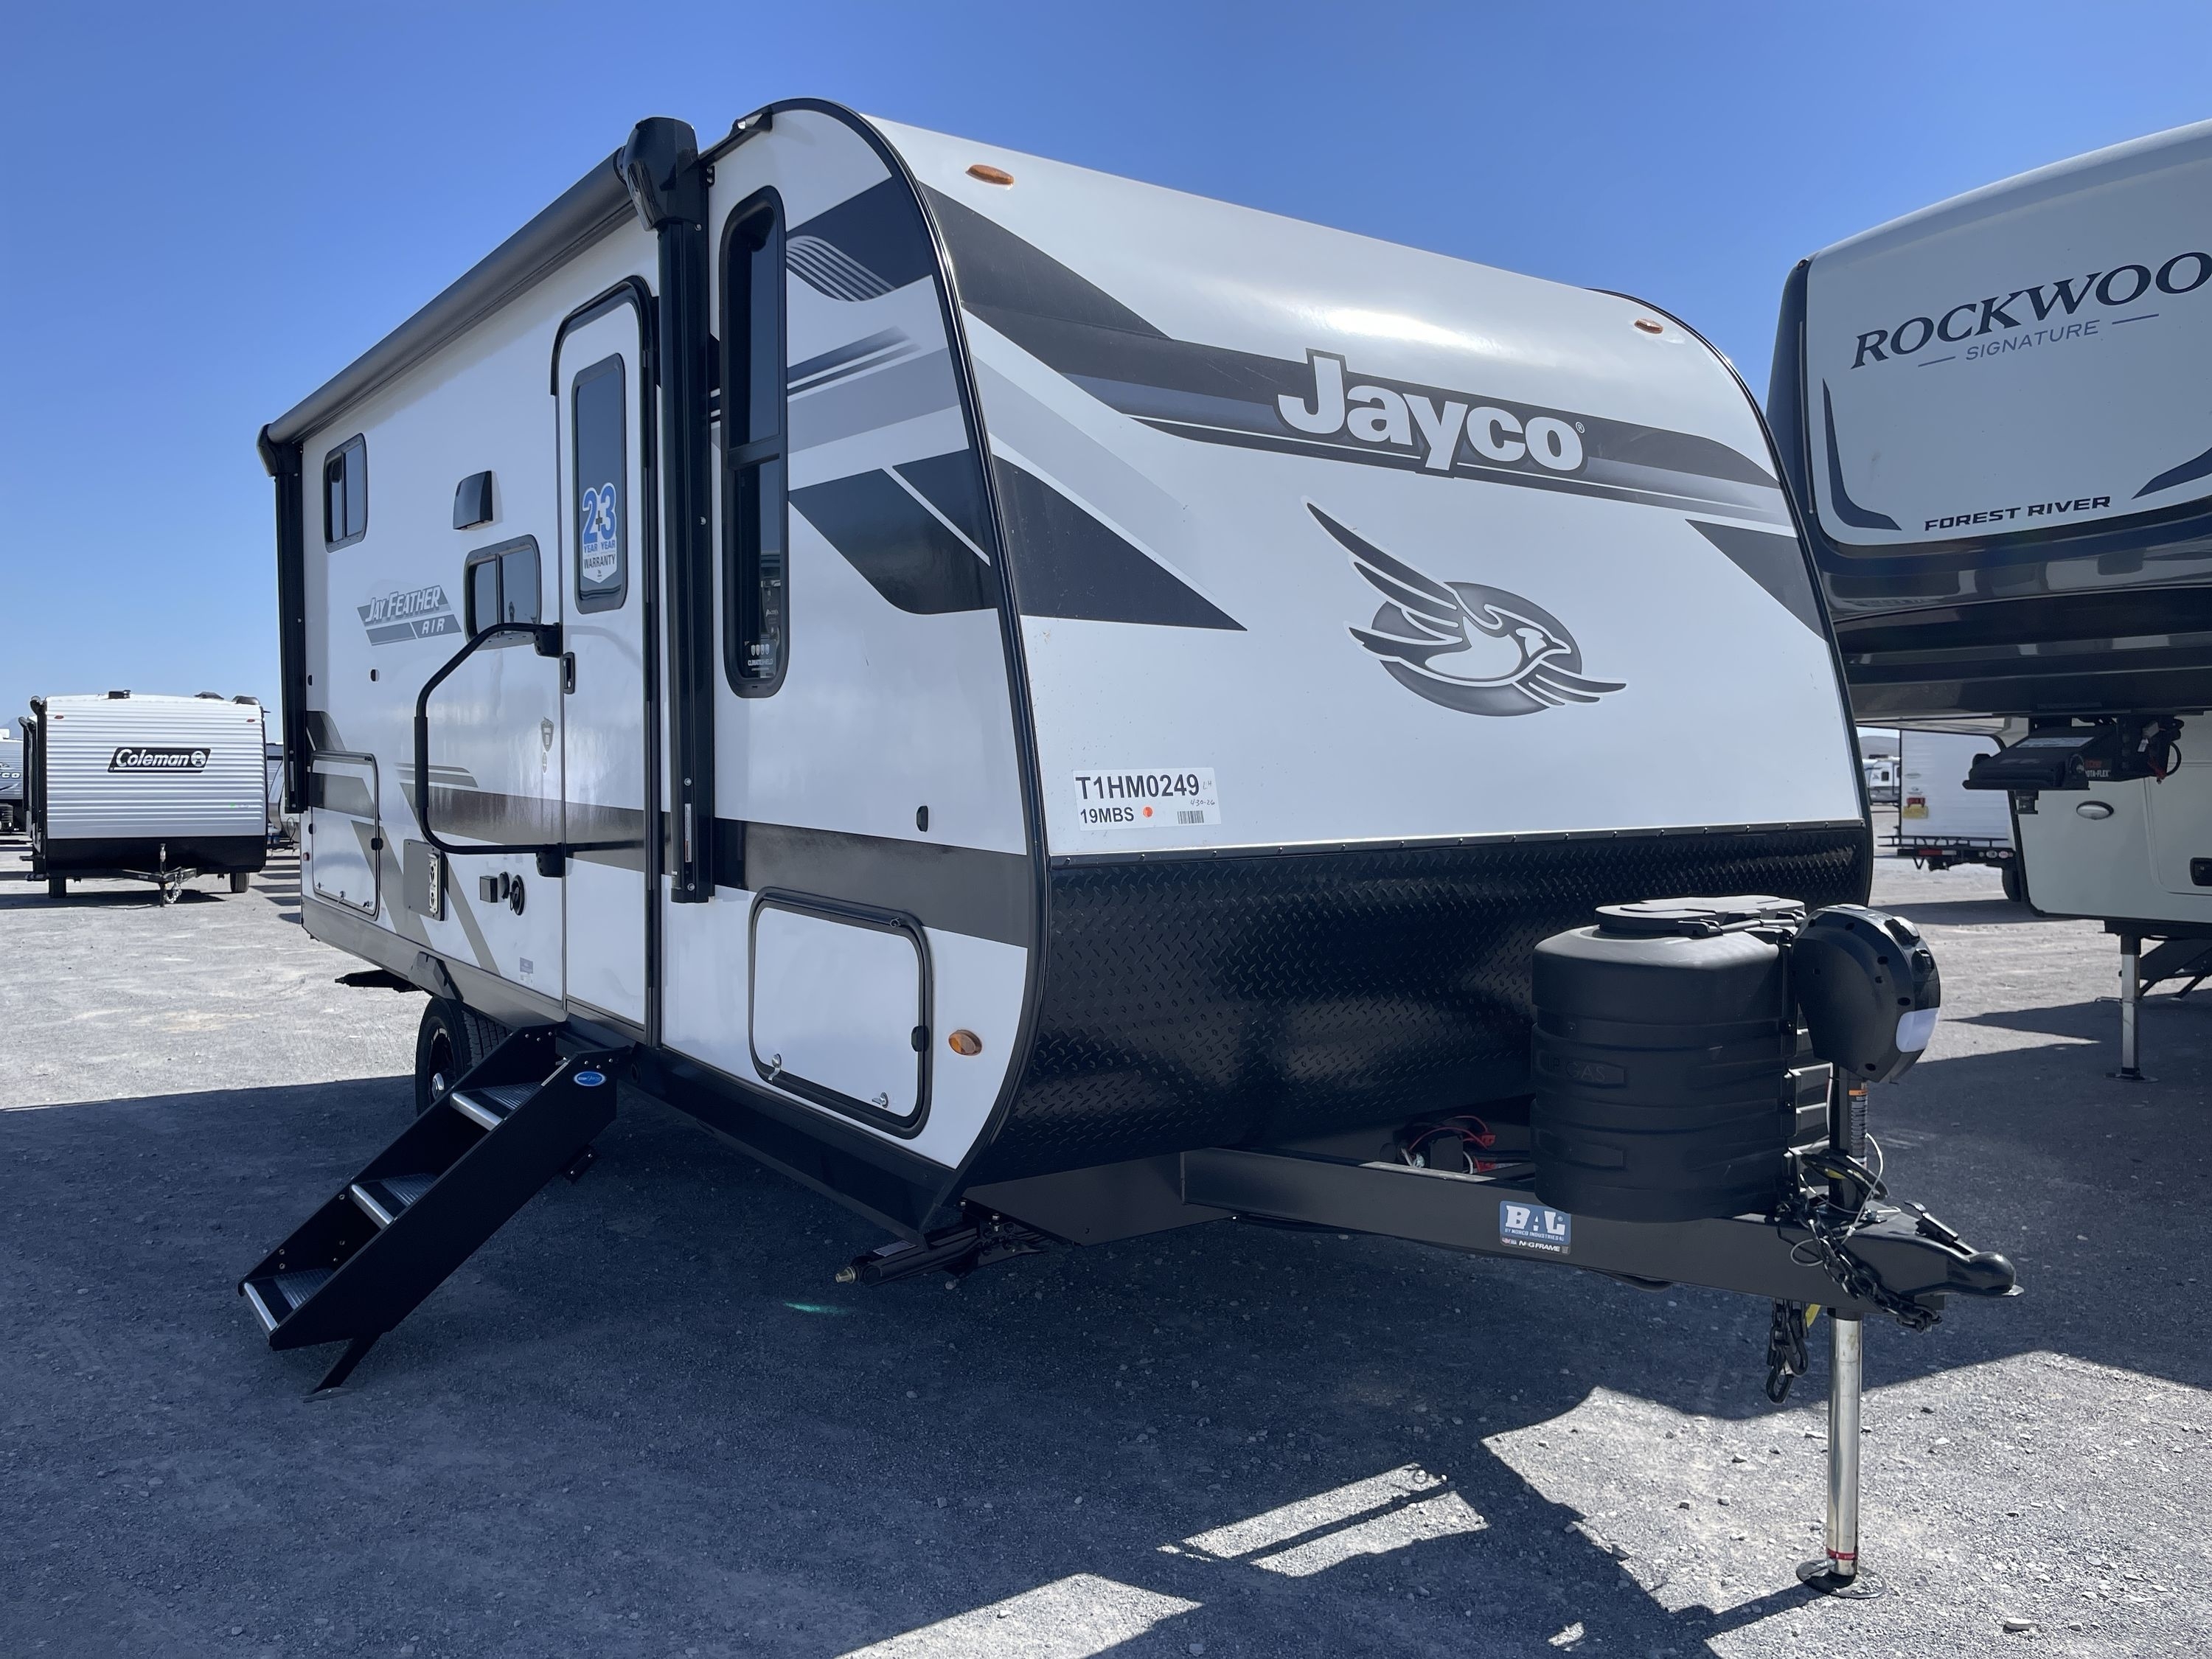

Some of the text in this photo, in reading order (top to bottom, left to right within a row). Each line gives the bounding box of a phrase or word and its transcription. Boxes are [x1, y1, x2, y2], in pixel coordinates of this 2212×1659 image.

[1965, 319, 2101, 361] SIGNATURE
[1278, 355, 1584, 471] Jayco
[1924, 495, 2111, 532] FOREST RIVER
[584, 543, 598, 554] YEAR
[601, 539, 616, 550] YEAR
[584, 554, 616, 569] WARRANTY
[365, 586, 441, 622] JAY FEATHER
[422, 618, 445, 634] AIR
[116, 748, 189, 768] Coleman
[1075, 773, 1200, 800] T1HM0249
[1080, 807, 1135, 824] 19MBS
[1566, 1061, 1605, 1082] GAS
[1506, 1205, 1565, 1236] BAL
[1529, 1231, 1559, 1241] INDUSTRIES
[1535, 1244, 1561, 1252] FRAME
